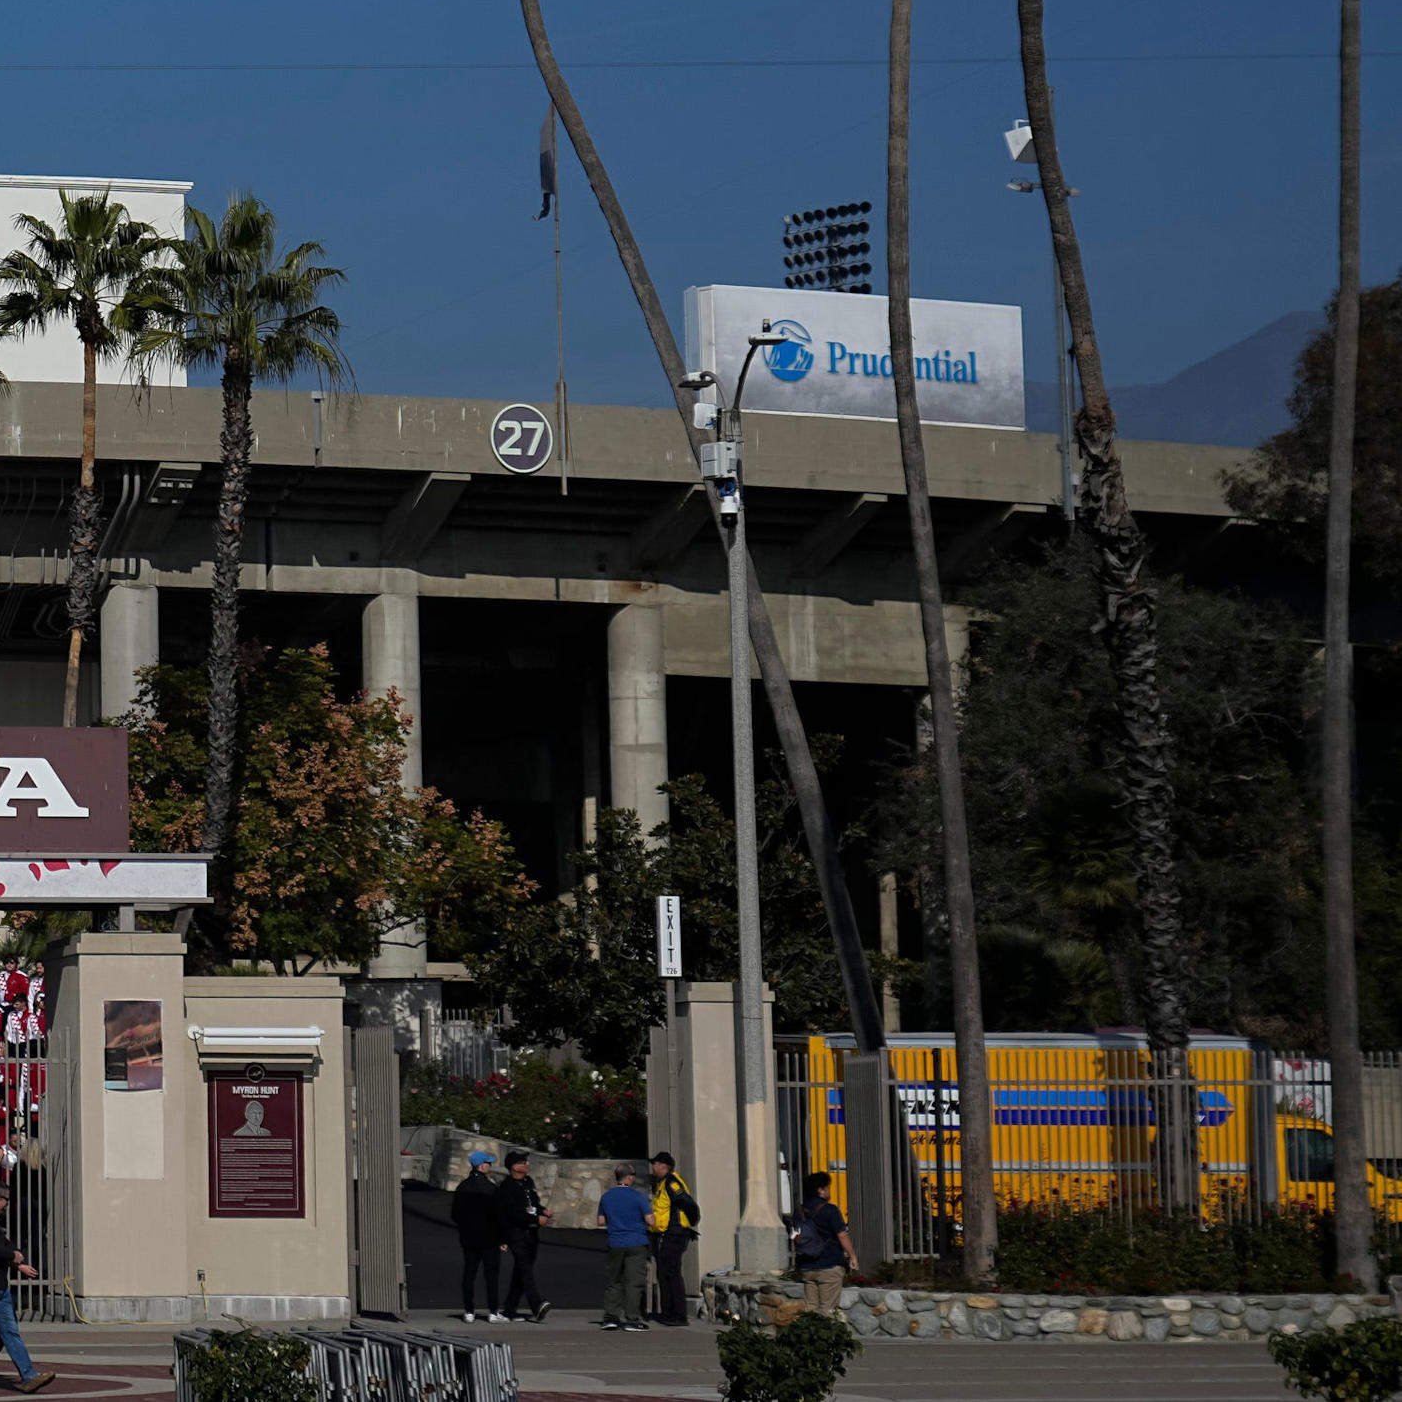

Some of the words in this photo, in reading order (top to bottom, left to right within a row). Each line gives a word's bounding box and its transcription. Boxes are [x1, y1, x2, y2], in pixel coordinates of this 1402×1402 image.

[826, 341, 978, 384] Pruntial
[499, 420, 545, 456] 27
[667, 899, 675, 963] EXIT
[232, 1086, 259, 1094] MYRON
[260, 1086, 279, 1094] HUNT
